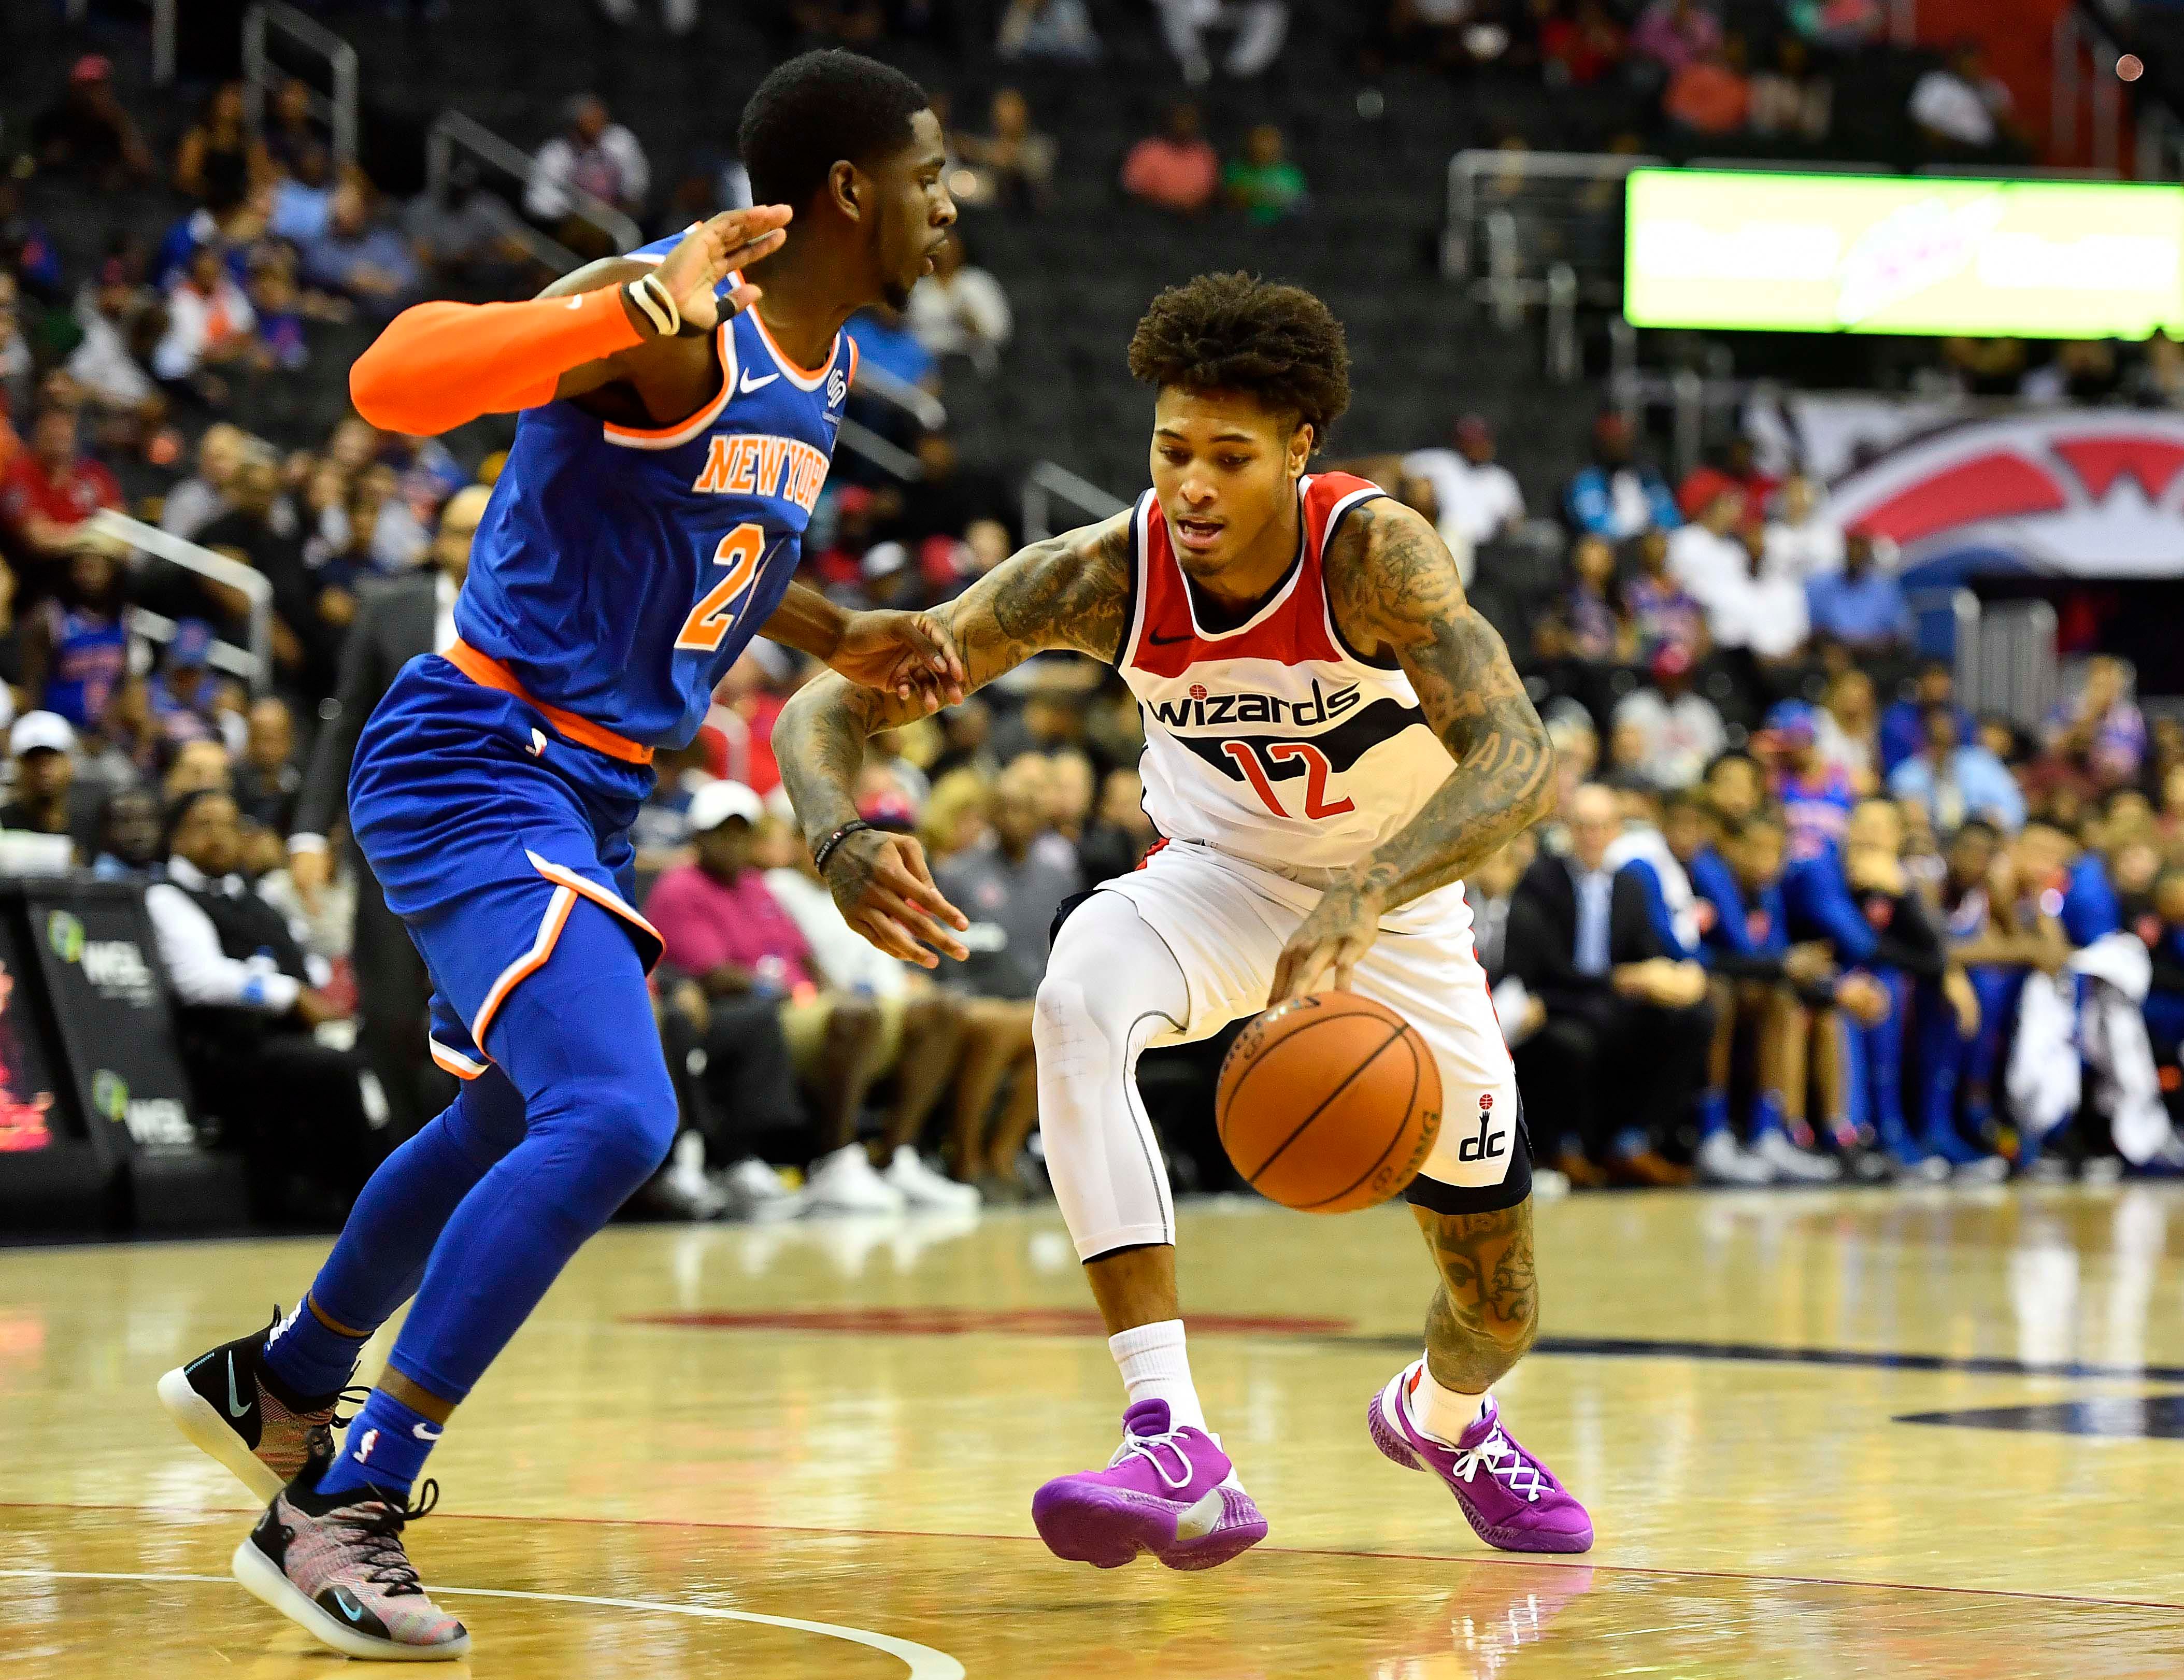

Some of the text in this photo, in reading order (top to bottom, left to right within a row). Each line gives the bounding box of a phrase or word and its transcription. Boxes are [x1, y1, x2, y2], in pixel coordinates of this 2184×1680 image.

[692, 434, 789, 497] NEW
[675, 523, 765, 651] 2
[1146, 678, 1361, 727] wizards
[1221, 739, 1357, 821] 12
[1459, 1110, 1505, 1162] dc
